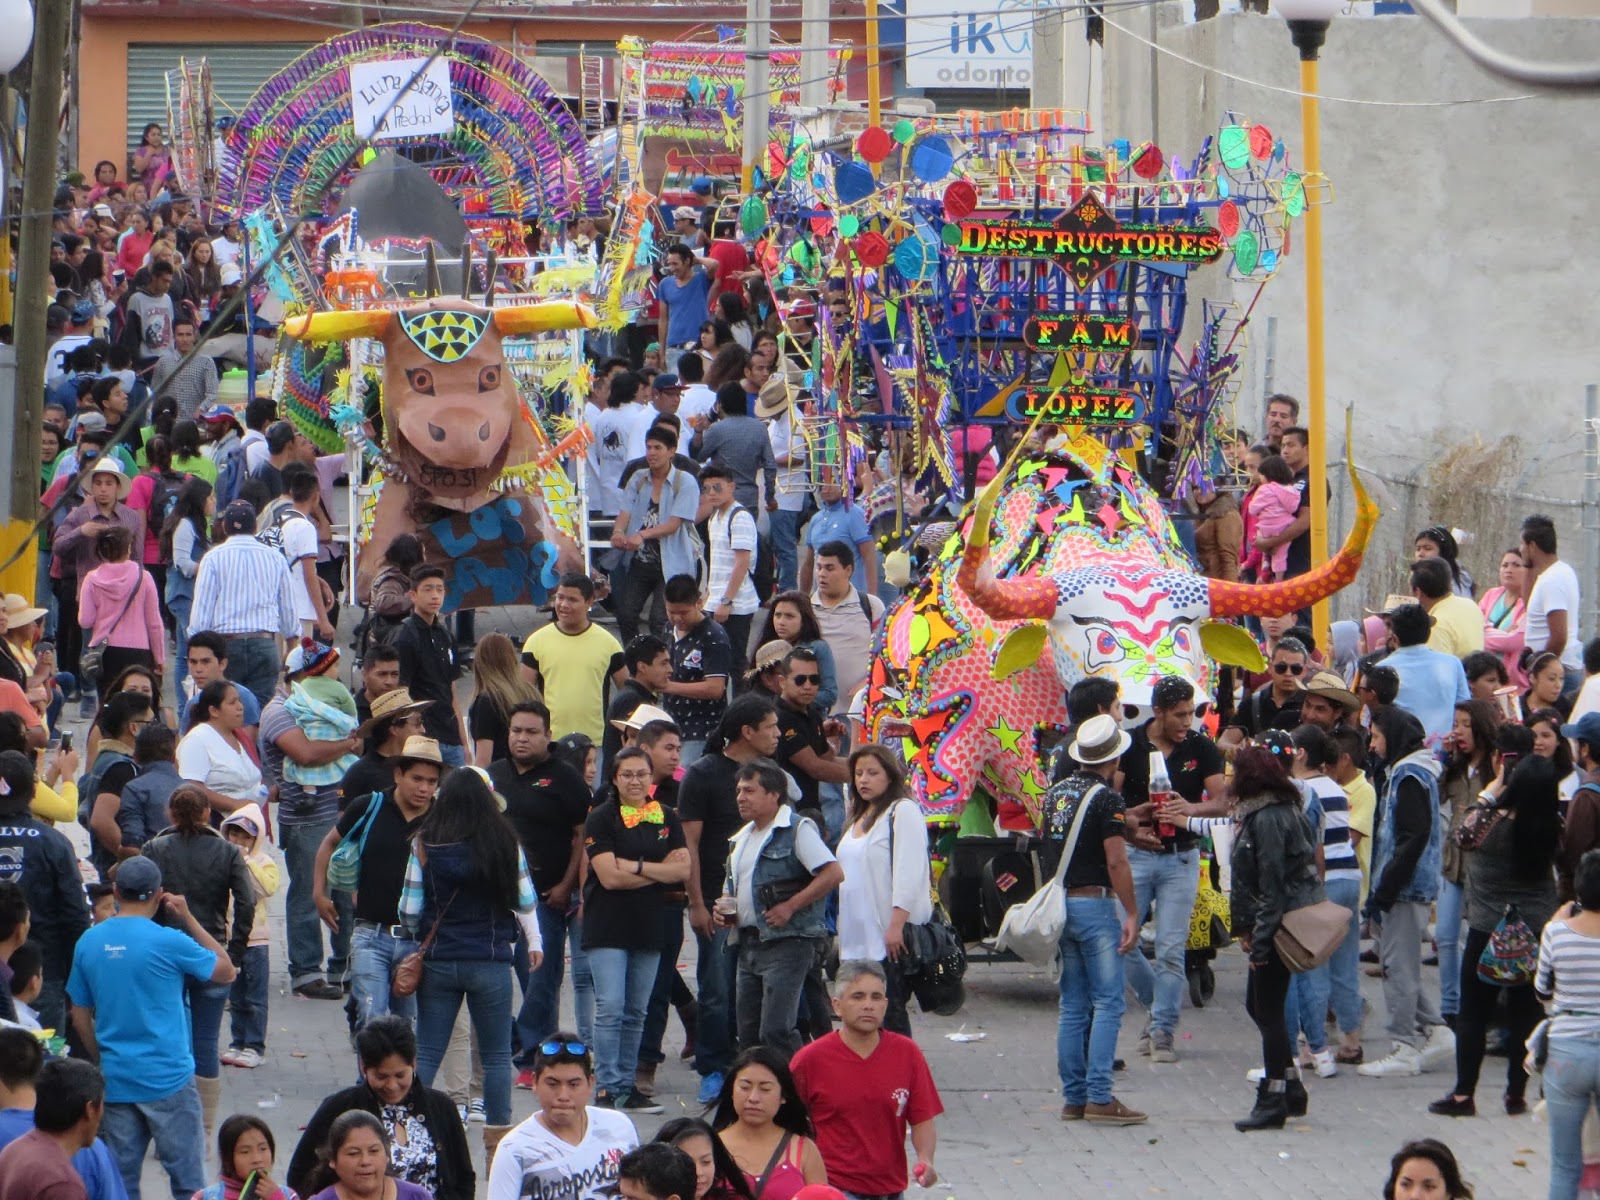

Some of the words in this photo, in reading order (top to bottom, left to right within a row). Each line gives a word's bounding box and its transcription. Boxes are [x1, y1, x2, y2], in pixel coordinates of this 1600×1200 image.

[937, 61, 1031, 83] odonto
[359, 74, 401, 106] Luna
[409, 69, 450, 116] Blanca
[393, 104, 432, 129] Piedad
[960, 222, 1219, 257] DESTRUCTORES
[1037, 320, 1131, 346] FAM
[1024, 393, 1135, 420] LOPEZ
